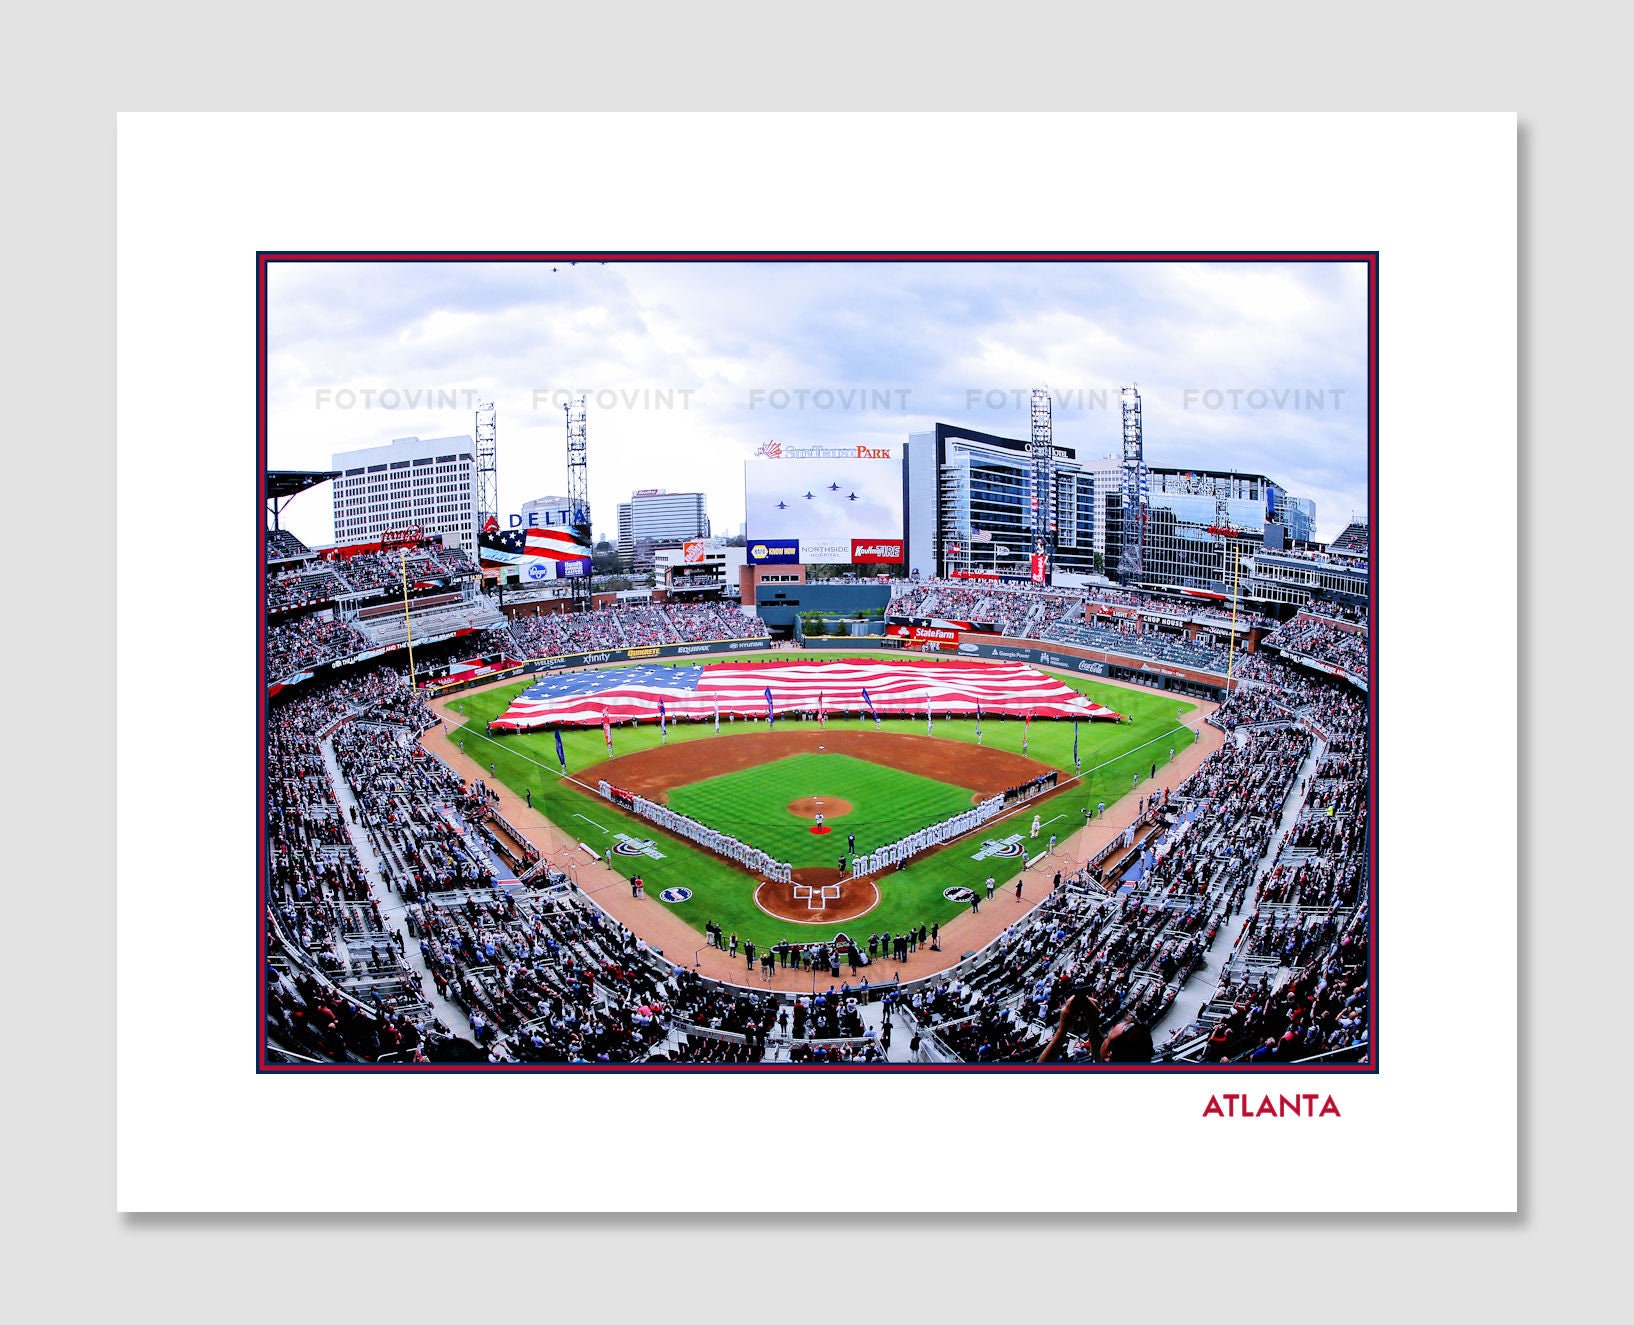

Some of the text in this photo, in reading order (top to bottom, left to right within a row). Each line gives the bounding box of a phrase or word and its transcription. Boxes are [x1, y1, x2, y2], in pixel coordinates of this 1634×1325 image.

[1166, 480, 1216, 491] COMCAST
[509, 509, 586, 528] DELTA
[1143, 615, 1184, 628] CHOP HOUSE
[678, 645, 711, 654] EQUIFAX
[739, 641, 764, 649] HYUNDAI
[583, 653, 610, 664] xfinity
[999, 650, 1016, 658] Georgia
